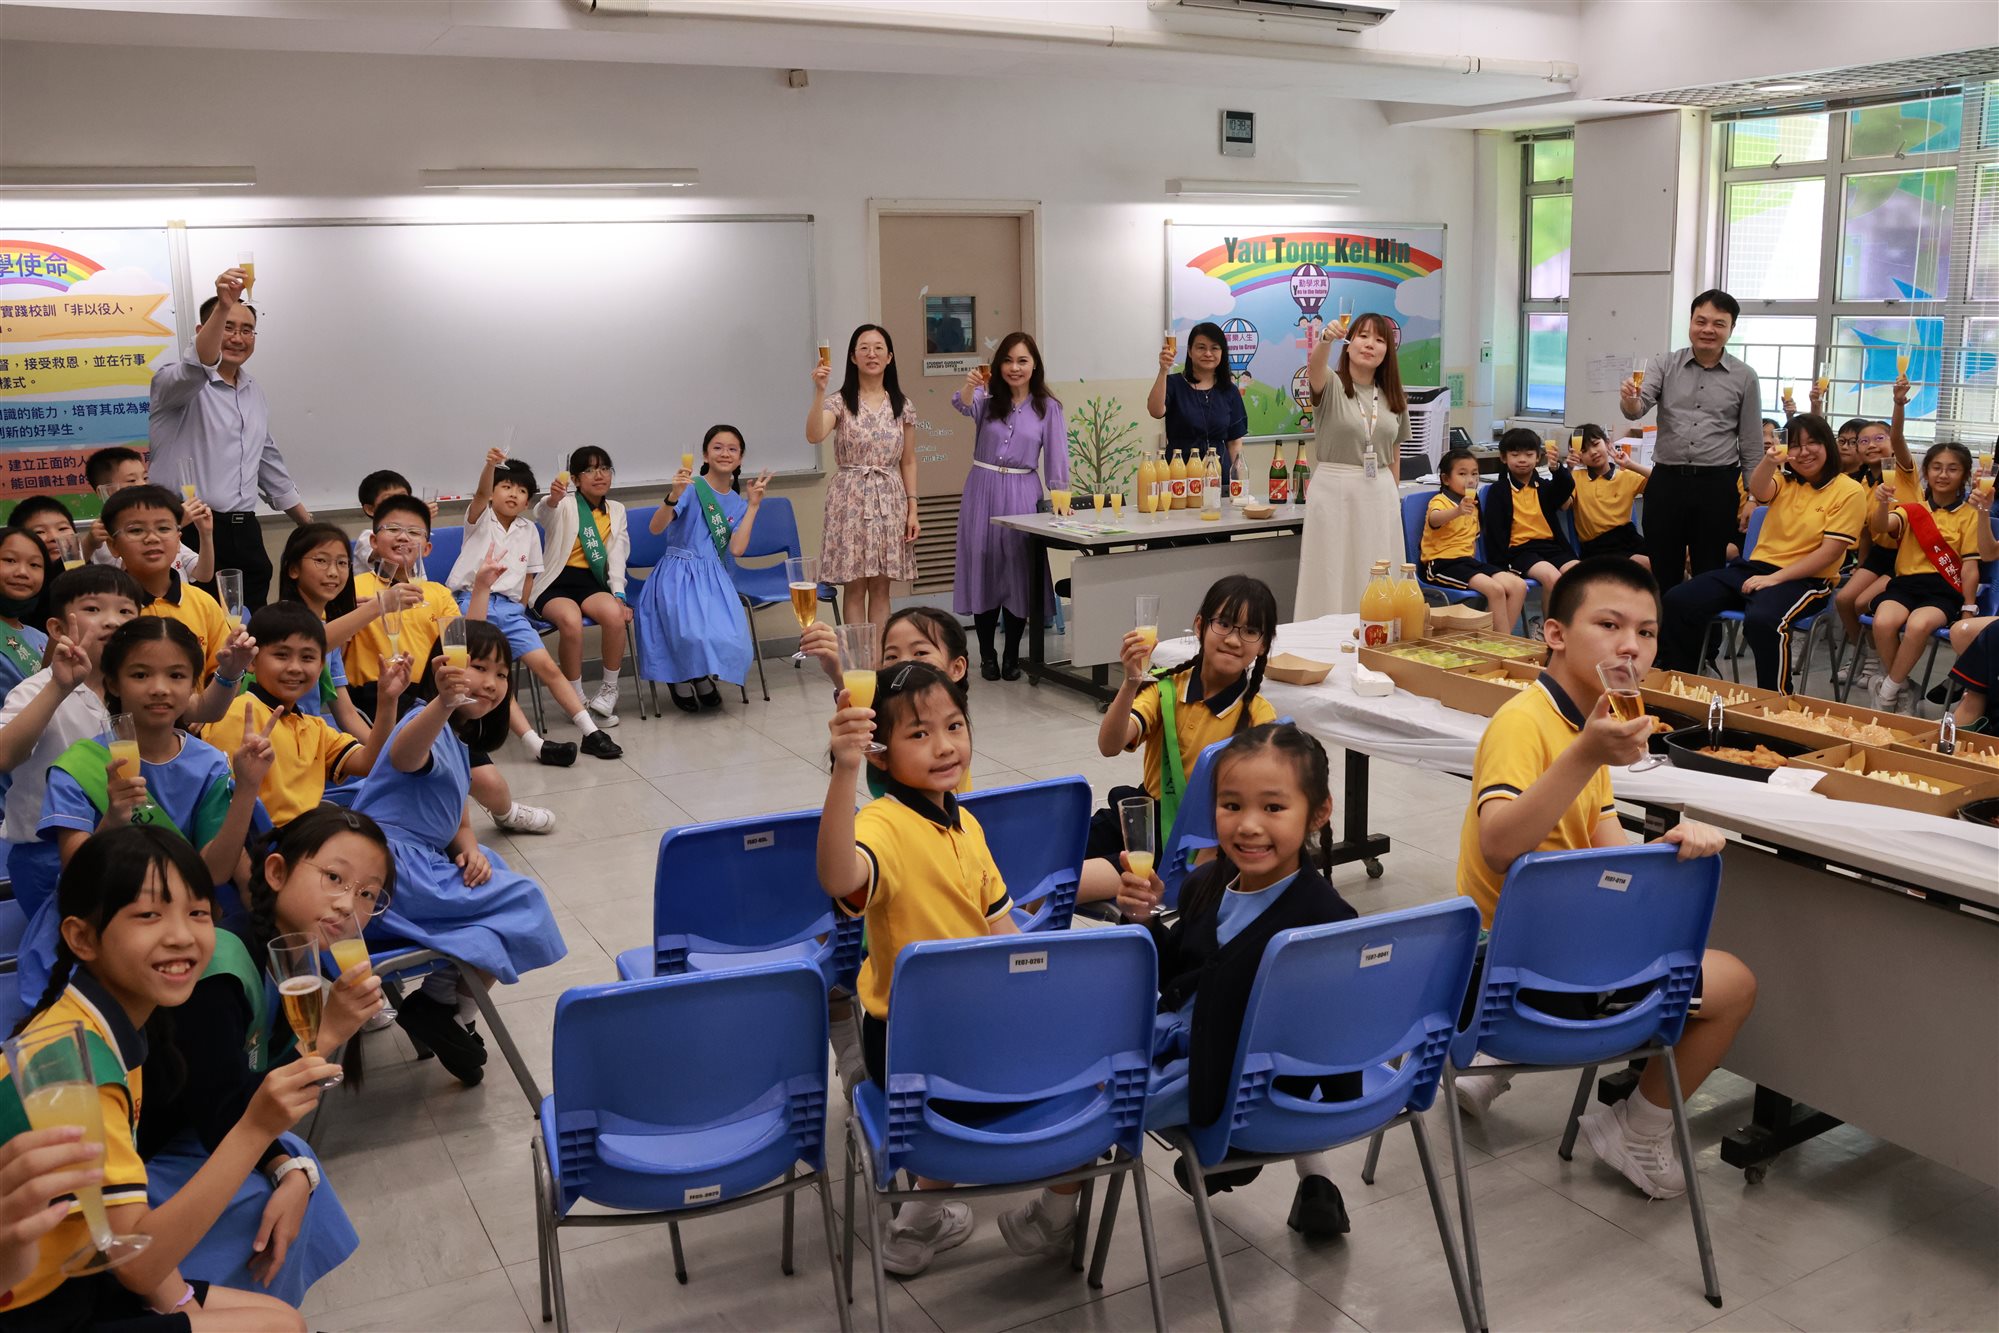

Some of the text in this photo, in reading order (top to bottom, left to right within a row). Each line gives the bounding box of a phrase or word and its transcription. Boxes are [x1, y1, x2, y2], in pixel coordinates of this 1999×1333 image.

[1224, 237, 1410, 266] Yau Tong Kei Hin
[0, 401, 150, 421] 識的能力，培育其成為樂
[583, 526, 604, 562] 領袖生
